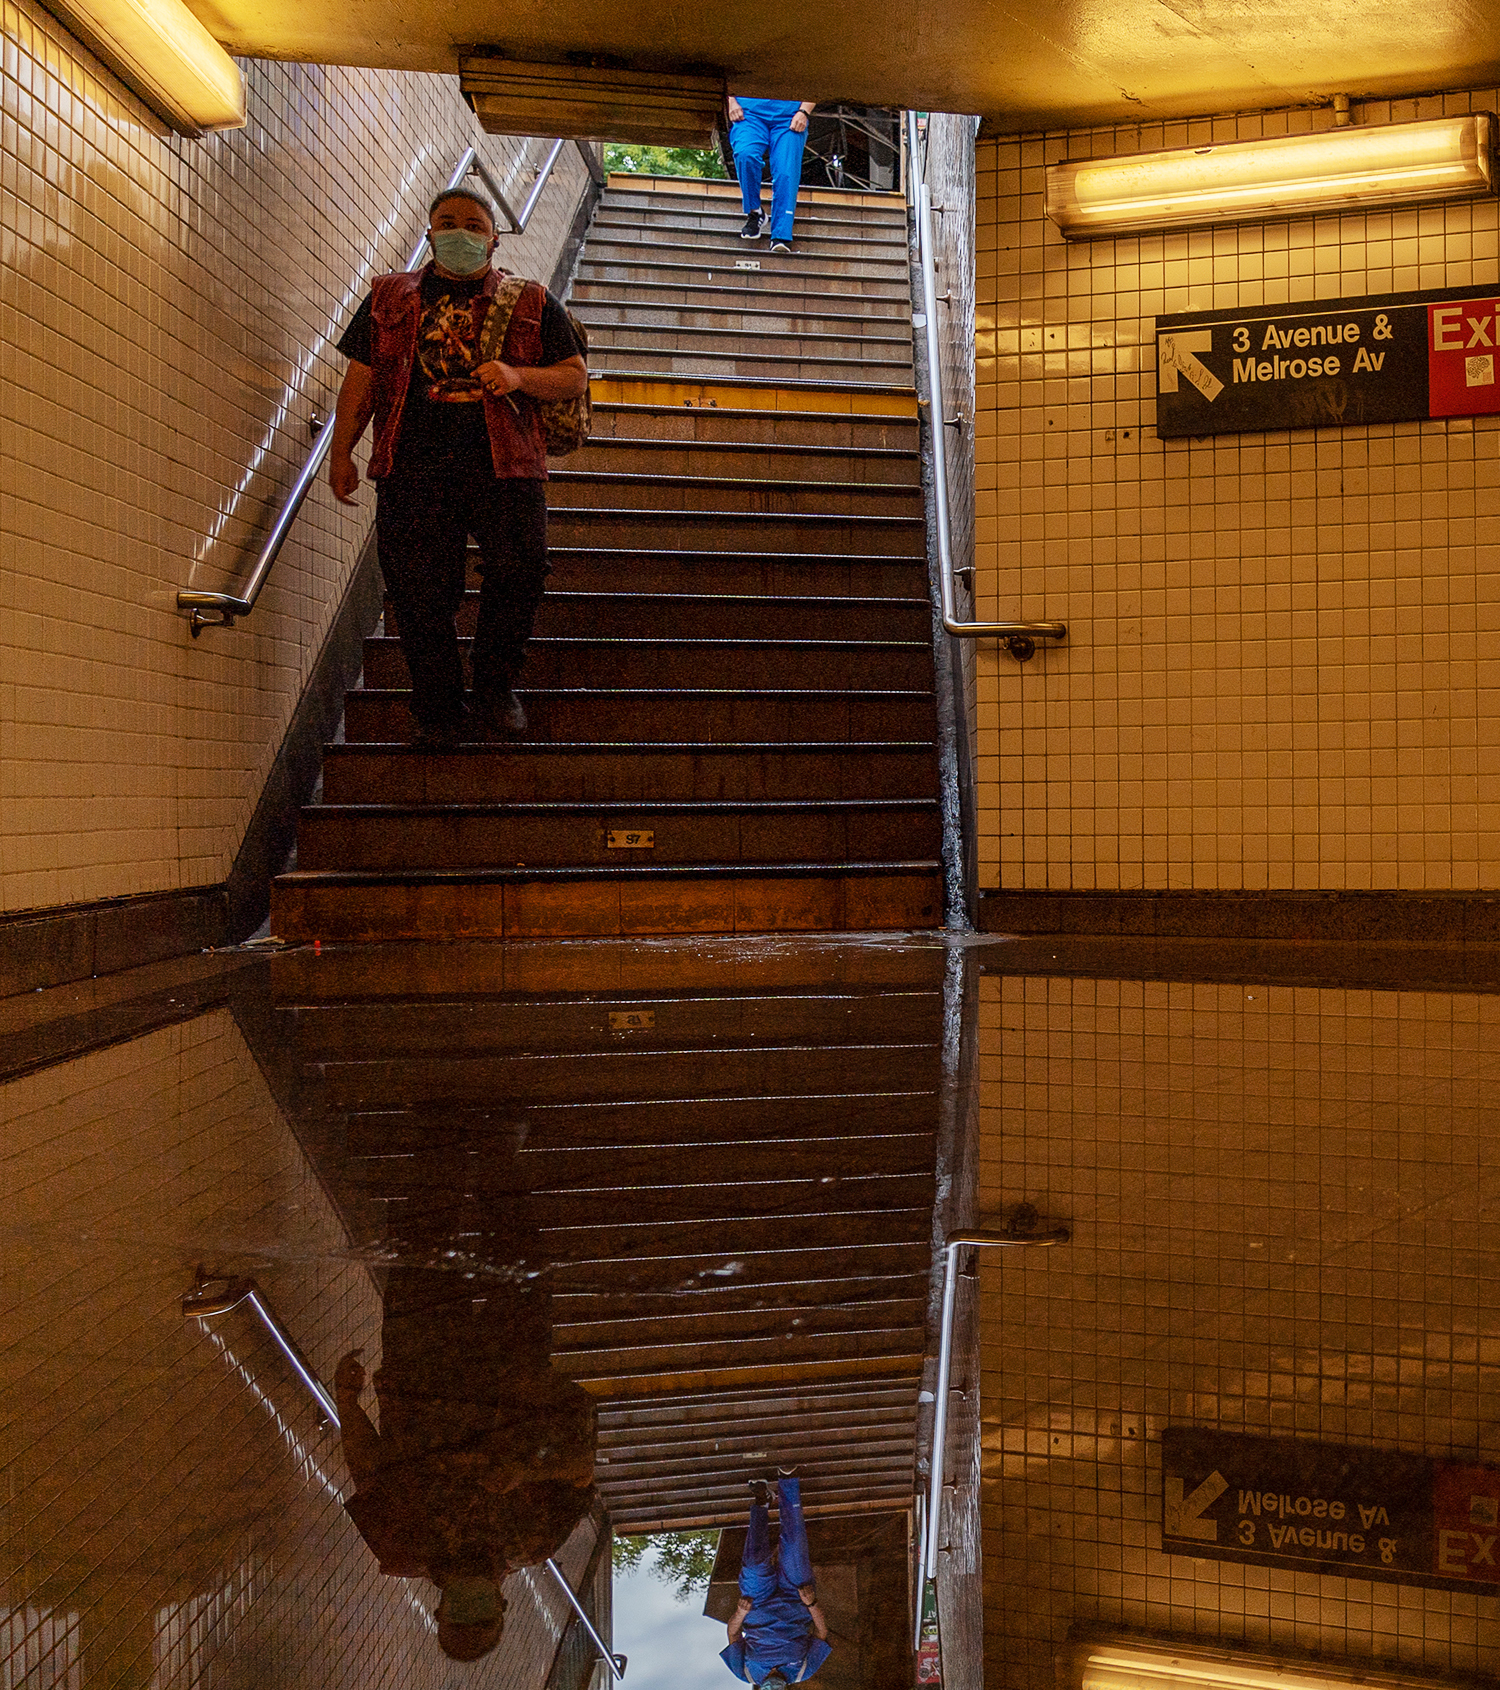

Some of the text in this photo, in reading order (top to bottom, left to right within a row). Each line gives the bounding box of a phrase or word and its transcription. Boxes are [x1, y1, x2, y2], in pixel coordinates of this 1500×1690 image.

[1232, 314, 1394, 352] 3 Avenue &
[1232, 355, 1341, 383] Melrose
[1352, 347, 1386, 374] Av
